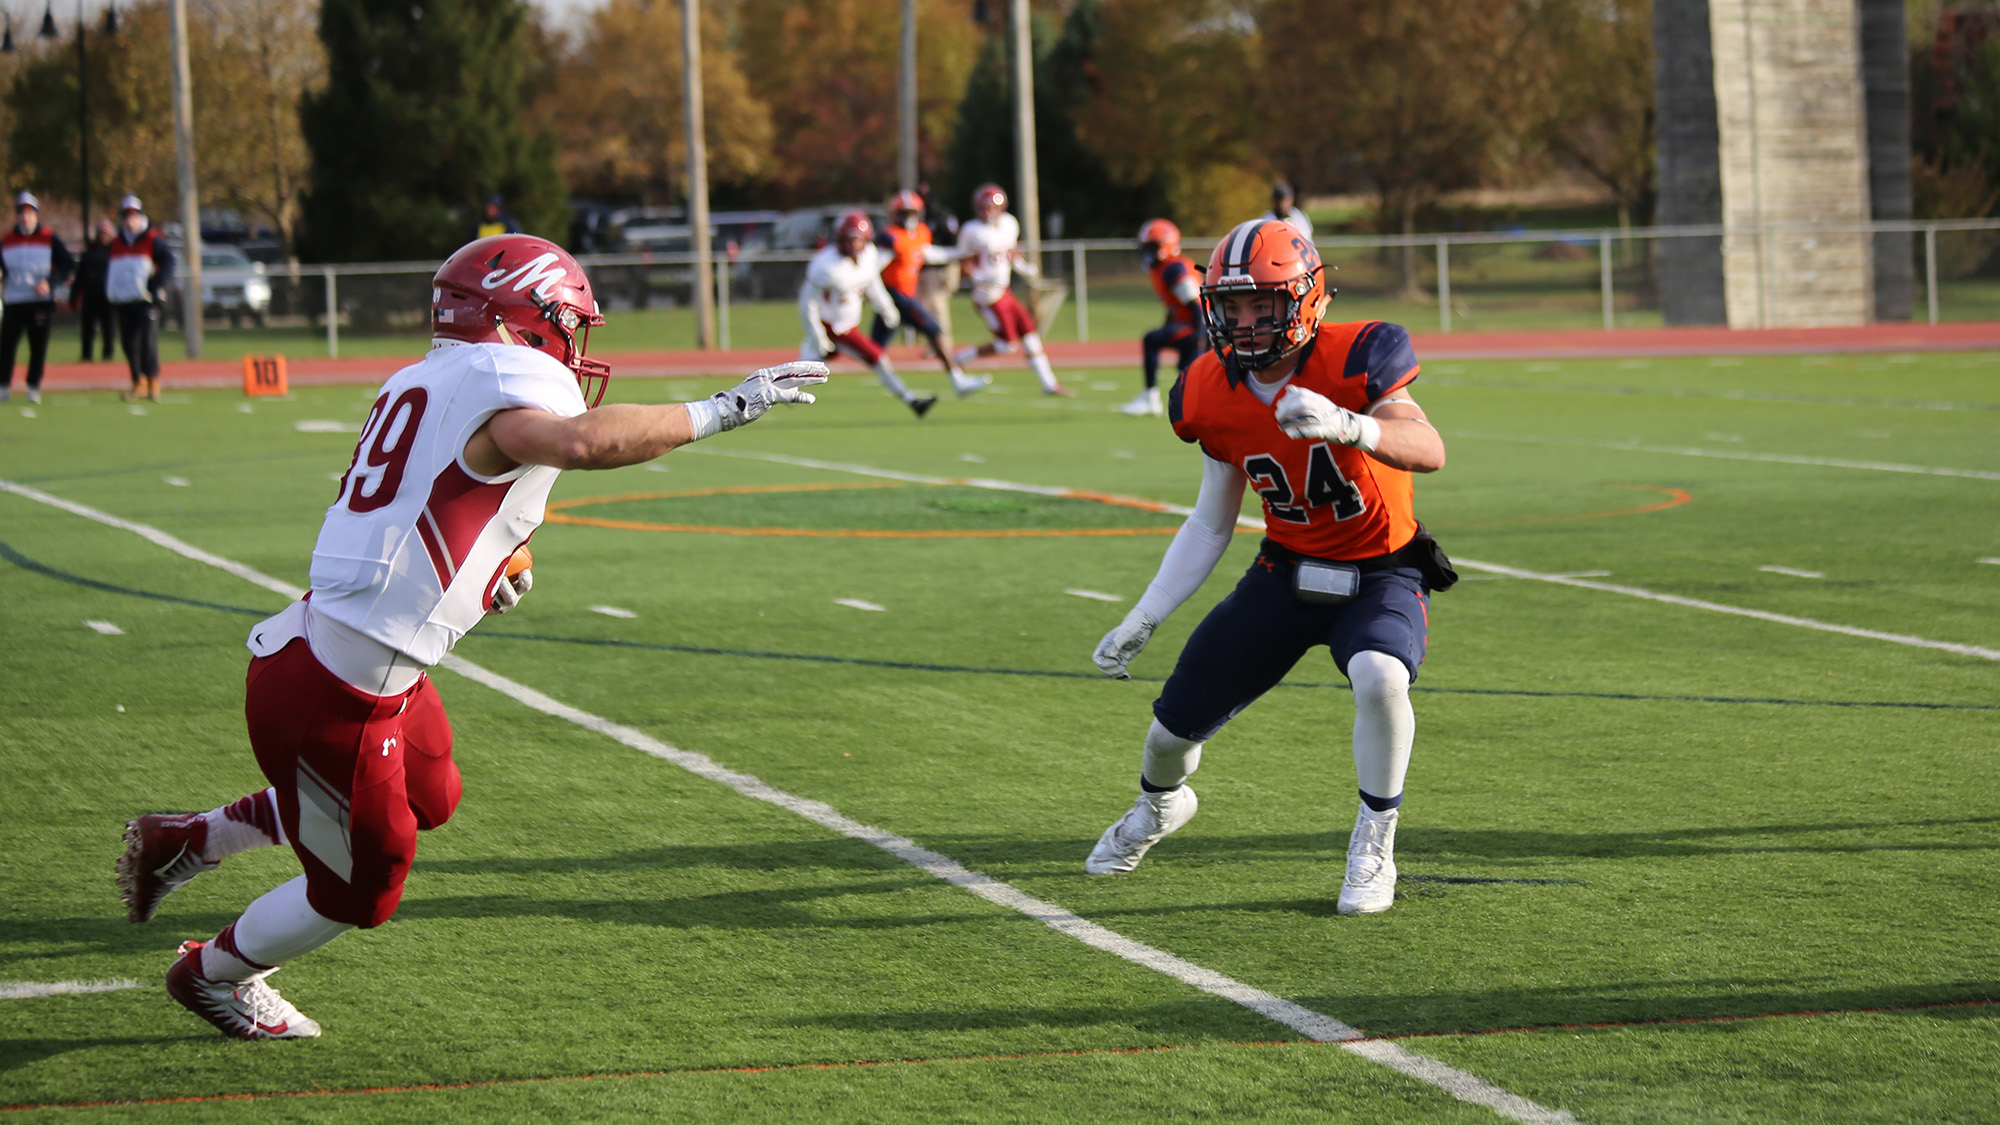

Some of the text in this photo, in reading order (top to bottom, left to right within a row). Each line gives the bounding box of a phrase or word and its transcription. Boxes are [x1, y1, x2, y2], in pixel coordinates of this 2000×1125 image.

[481, 252, 567, 300] M
[253, 360, 278, 386] 10
[1244, 442, 1367, 524] 24
